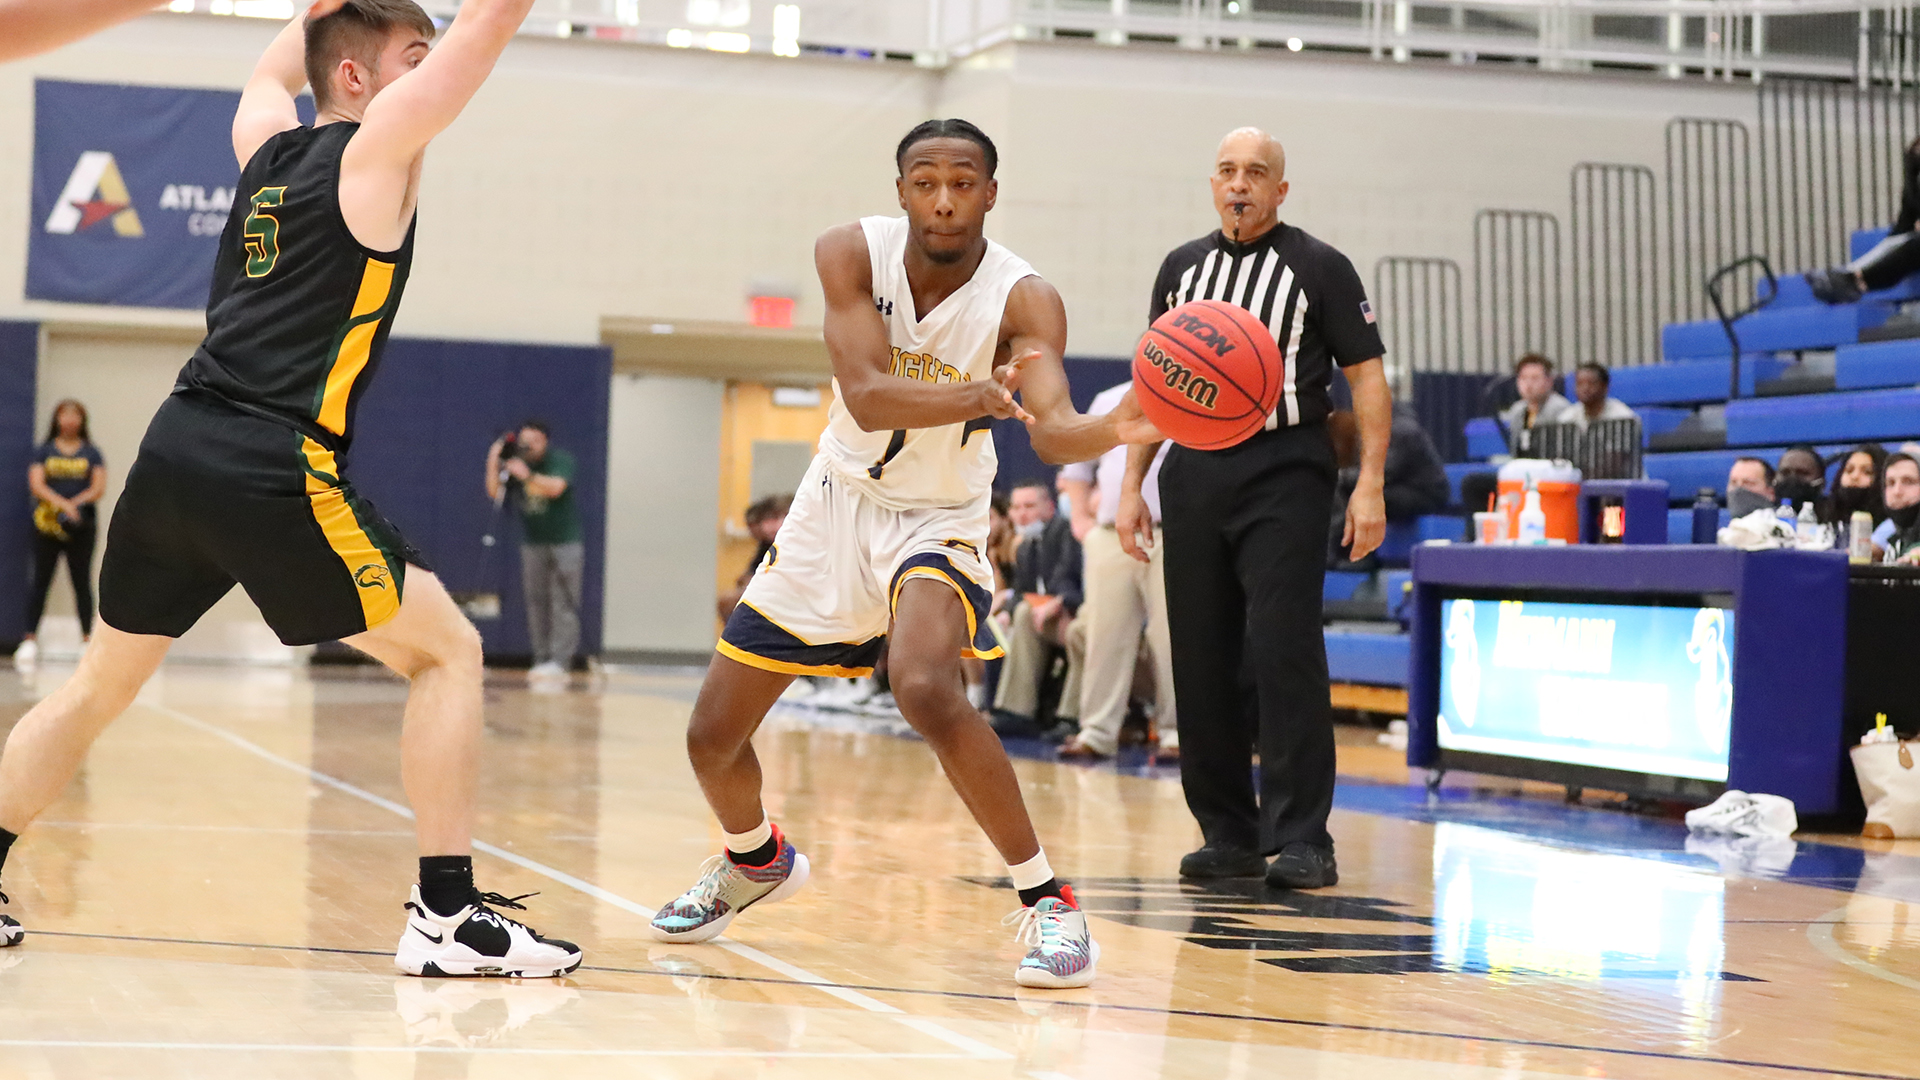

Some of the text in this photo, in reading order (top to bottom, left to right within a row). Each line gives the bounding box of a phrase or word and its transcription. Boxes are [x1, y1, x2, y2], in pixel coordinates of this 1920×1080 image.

[244, 186, 288, 278] 5
[1172, 312, 1236, 357] NCAA
[1143, 339, 1219, 409] Wilson
